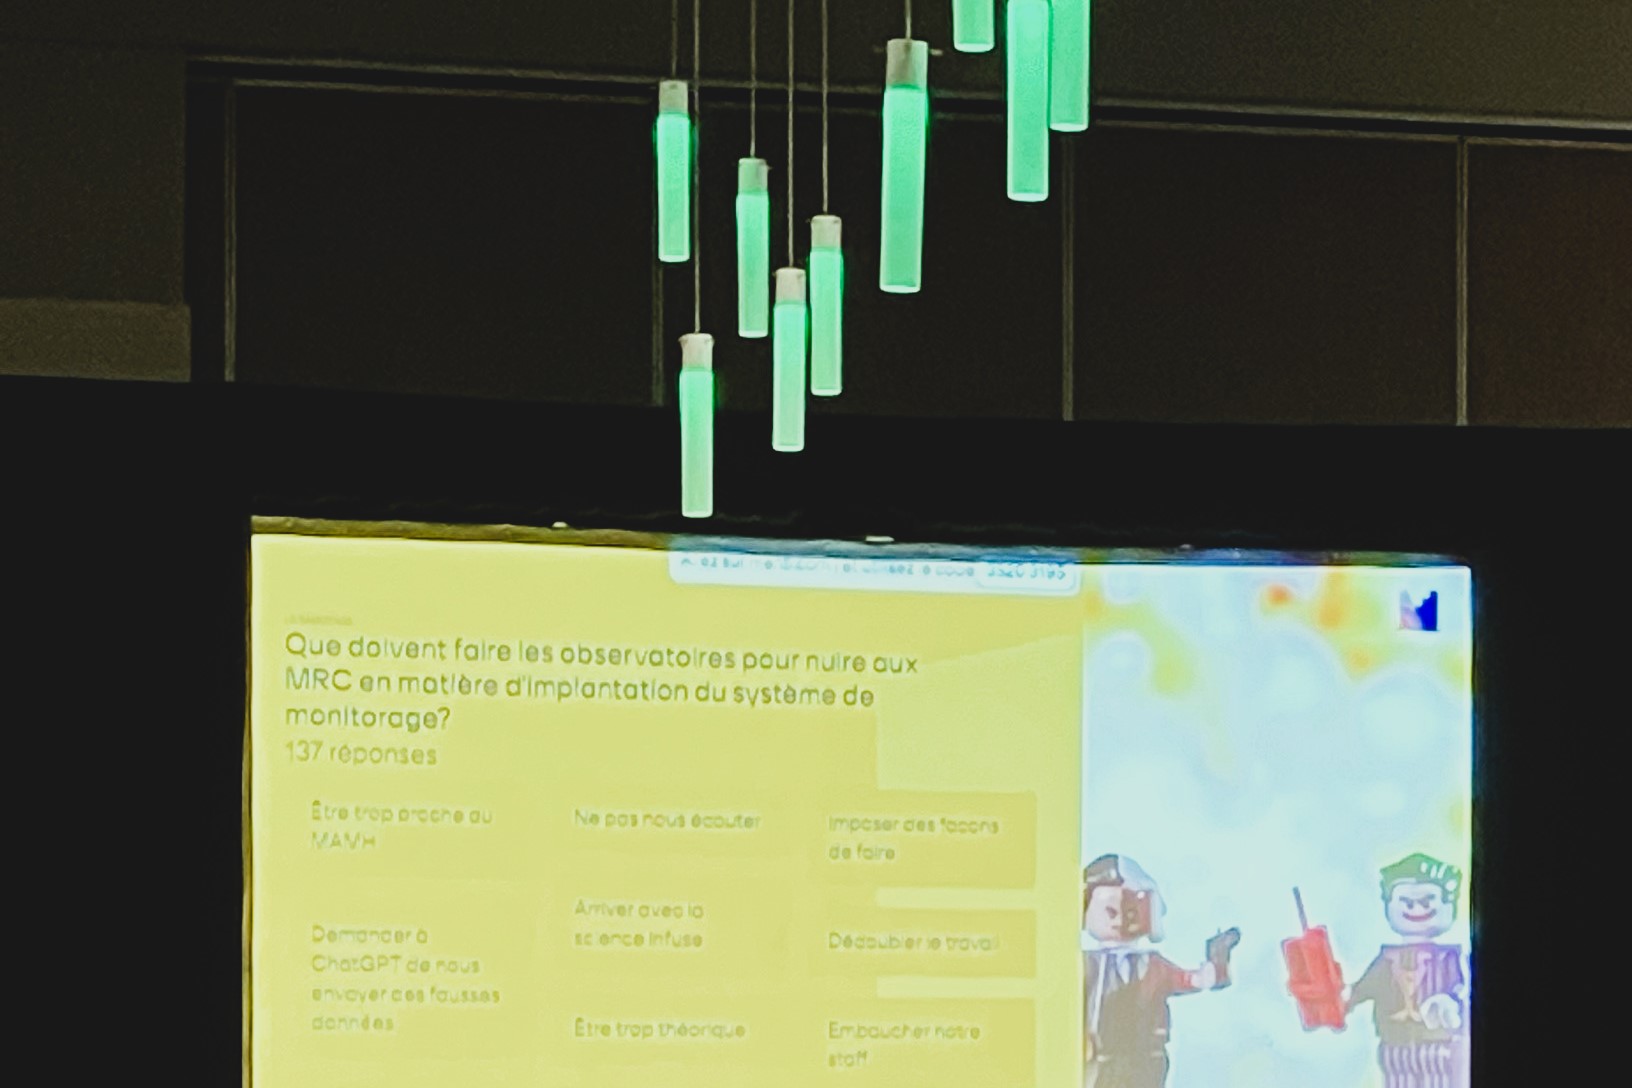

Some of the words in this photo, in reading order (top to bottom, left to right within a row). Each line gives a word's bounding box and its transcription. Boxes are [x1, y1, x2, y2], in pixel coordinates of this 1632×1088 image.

[284, 631, 341, 658] Que
[348, 636, 448, 661] doivent
[454, 637, 512, 661] faire
[518, 640, 553, 663] les
[559, 642, 735, 669] observatoires
[742, 652, 800, 671] pour
[806, 650, 867, 672] nuire
[872, 654, 919, 674] aux
[284, 666, 352, 691] MRC
[359, 674, 392, 692] en
[398, 671, 498, 695] matière
[505, 673, 688, 703] d'implantation
[694, 680, 726, 703] du
[732, 683, 836, 709] système
[842, 684, 875, 708] de
[284, 705, 451, 734] monitorage?
[284, 740, 324, 764] 137
[329, 741, 438, 767] réponses
[354, 805, 394, 823] trop
[573, 808, 600, 826] Ne
[604, 812, 638, 828] pas
[828, 842, 852, 861] de
[856, 842, 896, 861] faire
[311, 954, 402, 973] ChatGPT
[405, 957, 431, 974] de
[615, 1021, 654, 1039] trop
